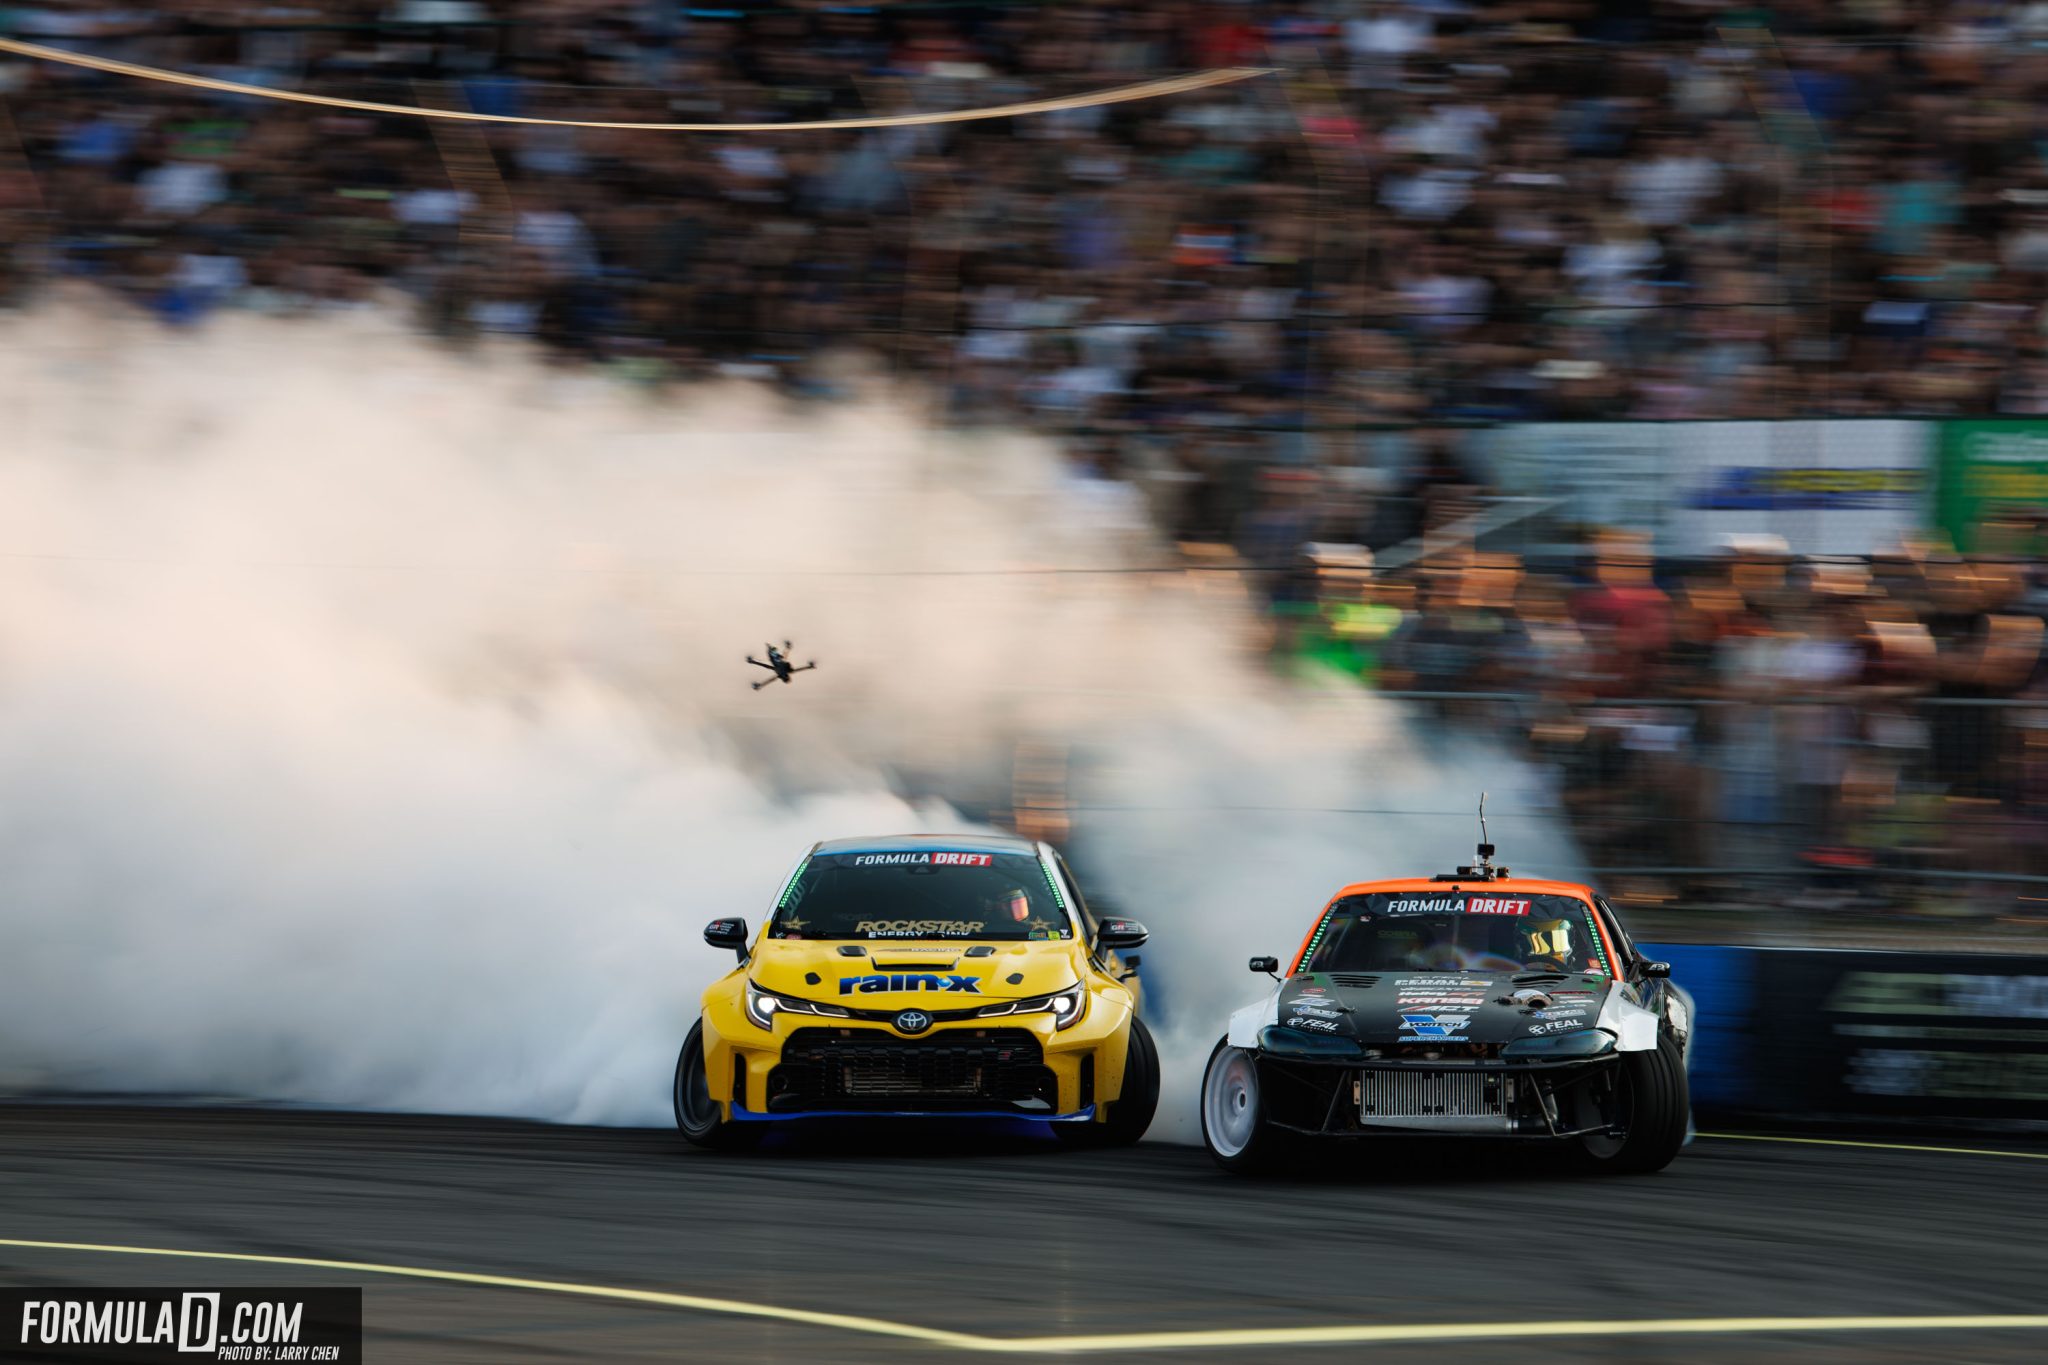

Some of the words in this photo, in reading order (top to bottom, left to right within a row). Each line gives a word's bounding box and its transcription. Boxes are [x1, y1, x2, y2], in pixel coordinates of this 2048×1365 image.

[855, 852, 931, 867] FORMULA
[933, 852, 991, 866] DRIFT
[1387, 898, 1466, 915] FORMULA
[1470, 898, 1529, 914] DRIFT
[855, 920, 985, 933] ROCKSTAR
[1302, 1018, 1340, 1031] FEAL
[1545, 1019, 1584, 1030] FEAL
